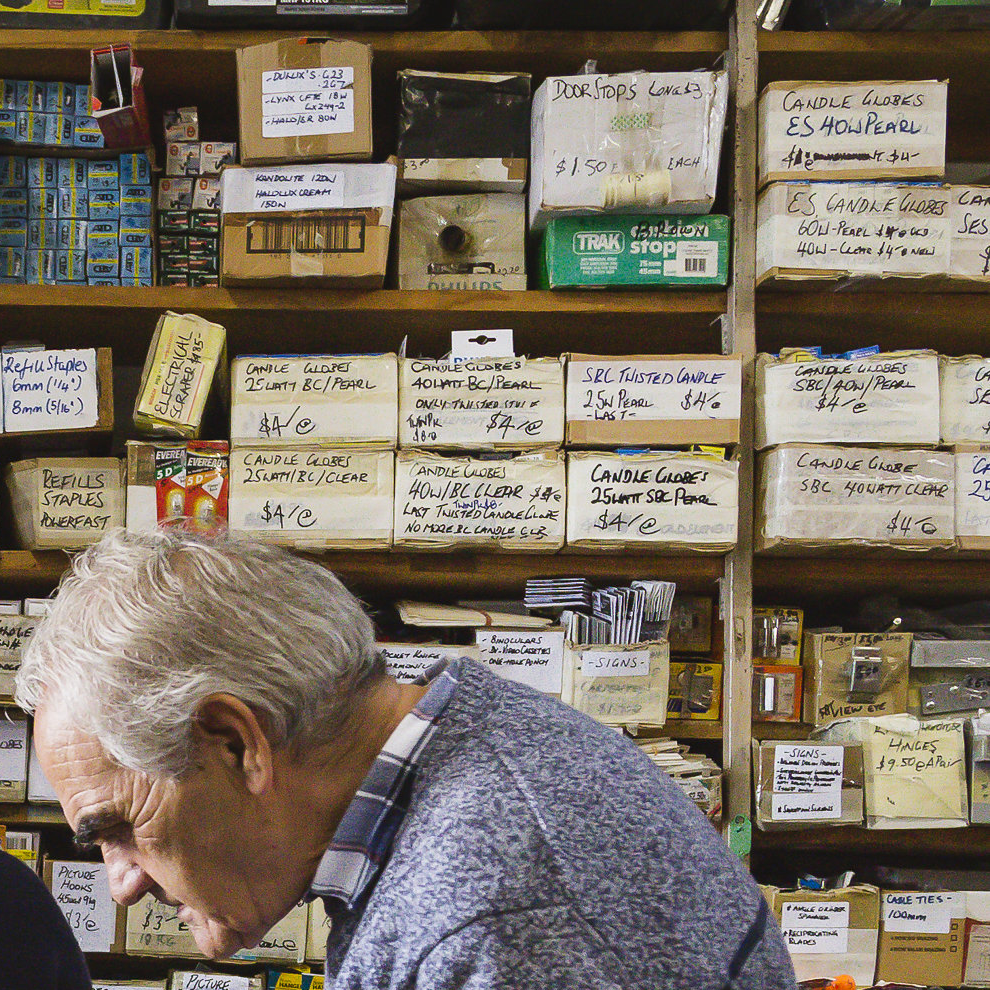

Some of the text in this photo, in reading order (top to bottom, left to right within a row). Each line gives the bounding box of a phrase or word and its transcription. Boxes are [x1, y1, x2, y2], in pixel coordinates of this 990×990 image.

[782, 89, 924, 112] CANDLE GLOBES
[786, 116, 814, 137] ES
[667, 156, 700, 170] EACH
[255, 174, 305, 184] KANDOLITE
[826, 193, 897, 213] CANDLE
[899, 193, 948, 216] GLOBES
[577, 233, 620, 251] TRAK
[4, 356, 88, 378] Refill Staples
[245, 362, 352, 375] CANDLE GLOBES
[411, 361, 521, 373] CANDLE GLOBES
[795, 363, 908, 377] CANDLE GLOBES
[619, 367, 674, 384] TWISTED
[677, 367, 726, 384] CANDLE
[12, 378, 43, 392] 6mm
[416, 399, 447, 409] ONLY
[618, 389, 654, 408] PEARL
[11, 400, 43, 414] 8mm
[243, 454, 352, 468] CANDLE GLOBES
[797, 453, 919, 473] CANDLE GLOBE
[410, 462, 506, 479] CANDLE GLOBES
[591, 464, 709, 484] CANDLE GLOBES
[43, 469, 105, 489] REFILLS
[474, 483, 524, 499] CLEAR
[800, 479, 831, 493] SBC
[905, 483, 949, 498] CLEAR
[41, 490, 104, 508] STAPLES
[646, 489, 674, 503] SBC
[675, 488, 717, 506] PEARL
[403, 502, 430, 517] LAST
[436, 503, 482, 520] TWISTED
[40, 512, 111, 530] POWERFAST
[405, 520, 420, 533] NO
[423, 523, 453, 533] MORE
[888, 738, 939, 753] HINGES
[58, 866, 100, 880] PICTURE
[61, 879, 93, 892] HOOKS
[886, 895, 944, 905] CABLE TIES
[887, 910, 927, 922] 100mm
[788, 938, 817, 946] BLADES
[186, 974, 232, 990] PICTURE
